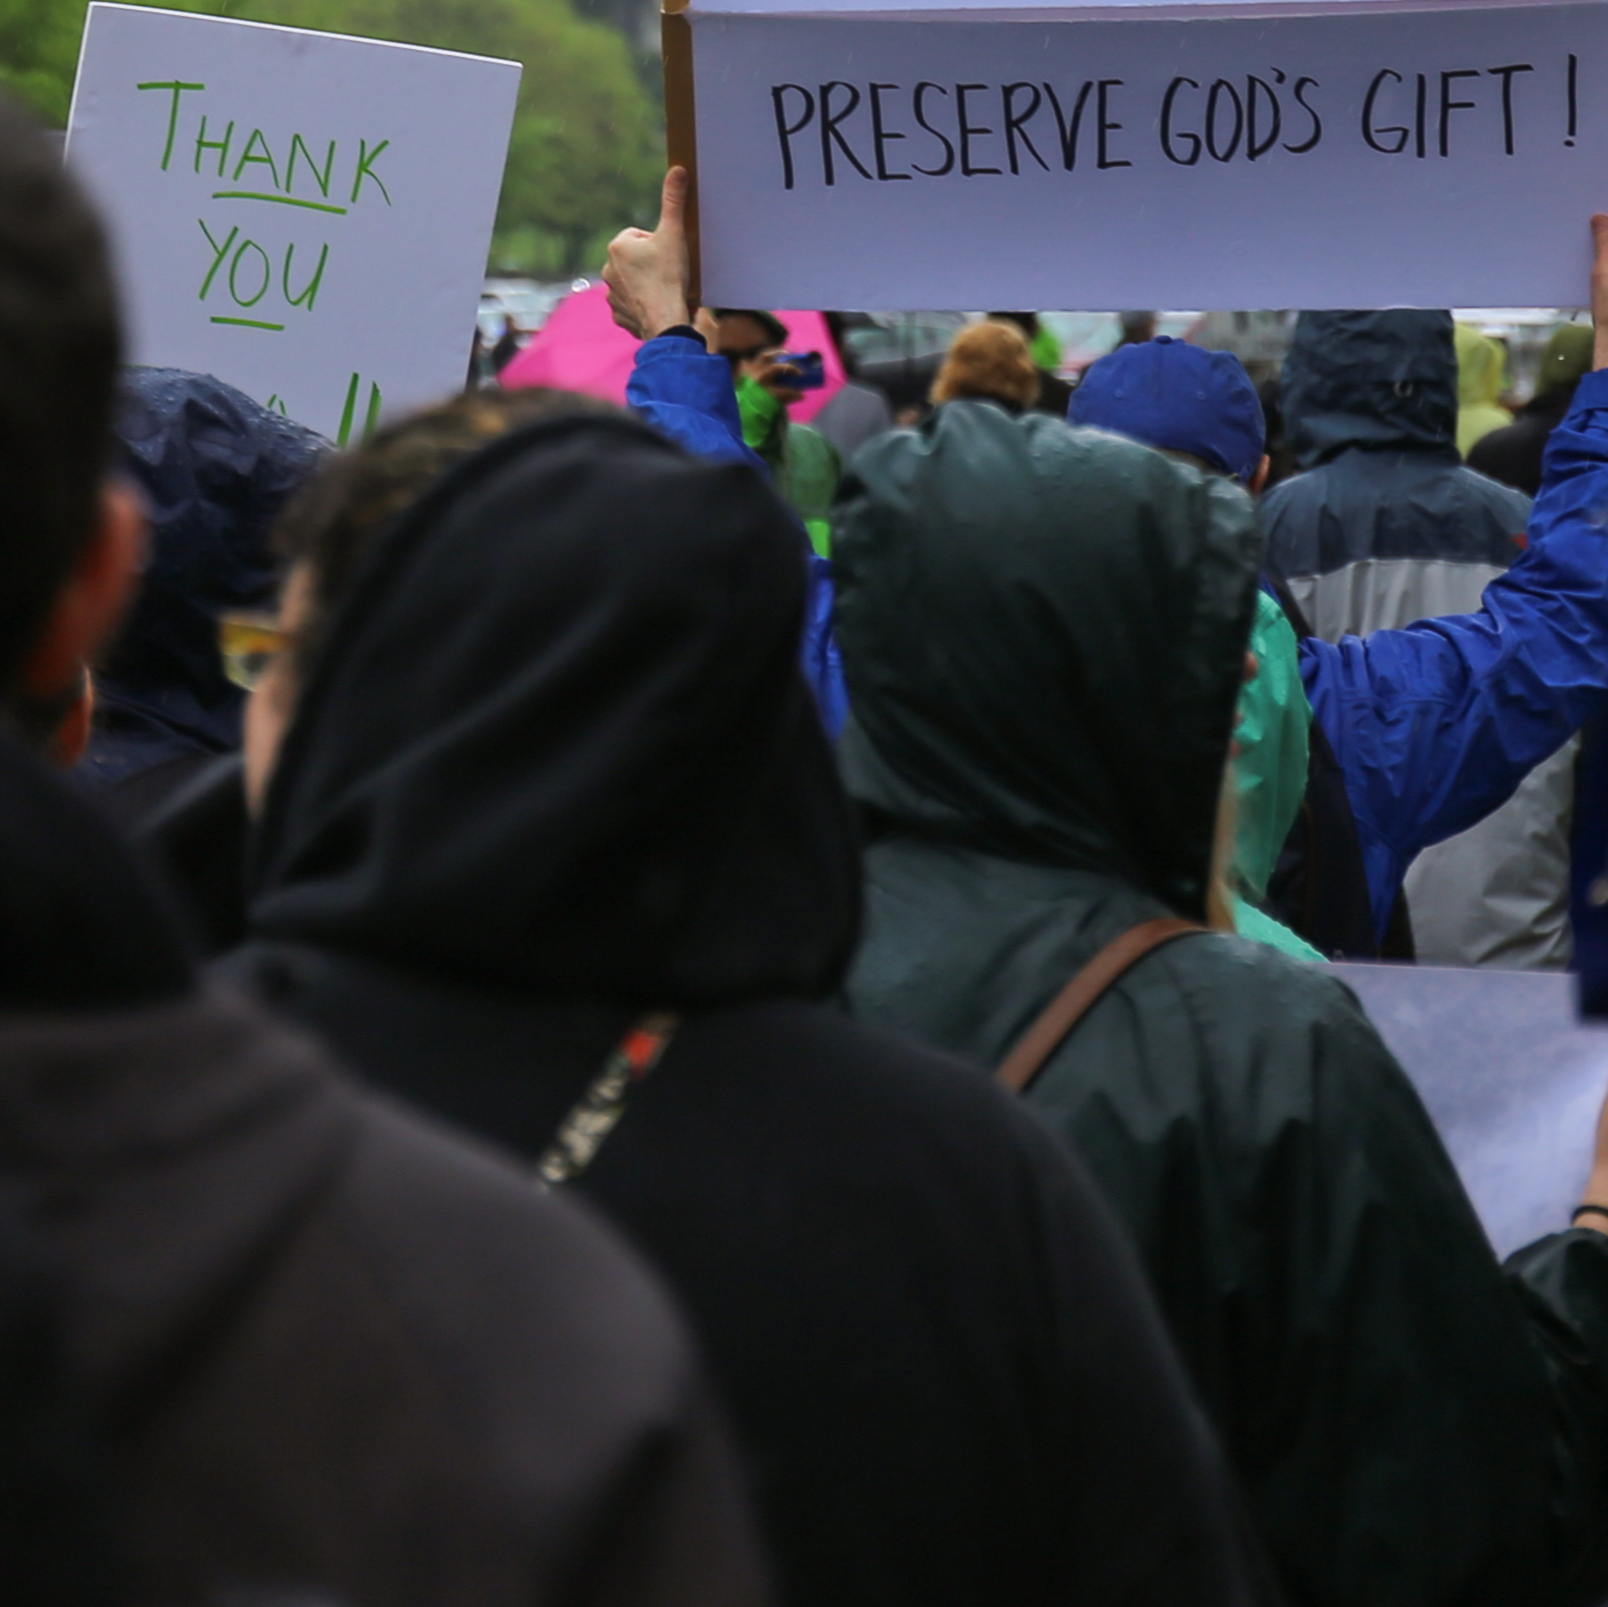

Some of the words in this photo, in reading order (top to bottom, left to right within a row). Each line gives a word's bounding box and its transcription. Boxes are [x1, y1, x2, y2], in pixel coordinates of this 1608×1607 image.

[136, 79, 391, 207] THANK
[770, 77, 1133, 191] PRESERVE
[1159, 66, 1322, 166] GOD'S
[1361, 63, 1536, 159] GIFT
[197, 218, 329, 311] YOU
